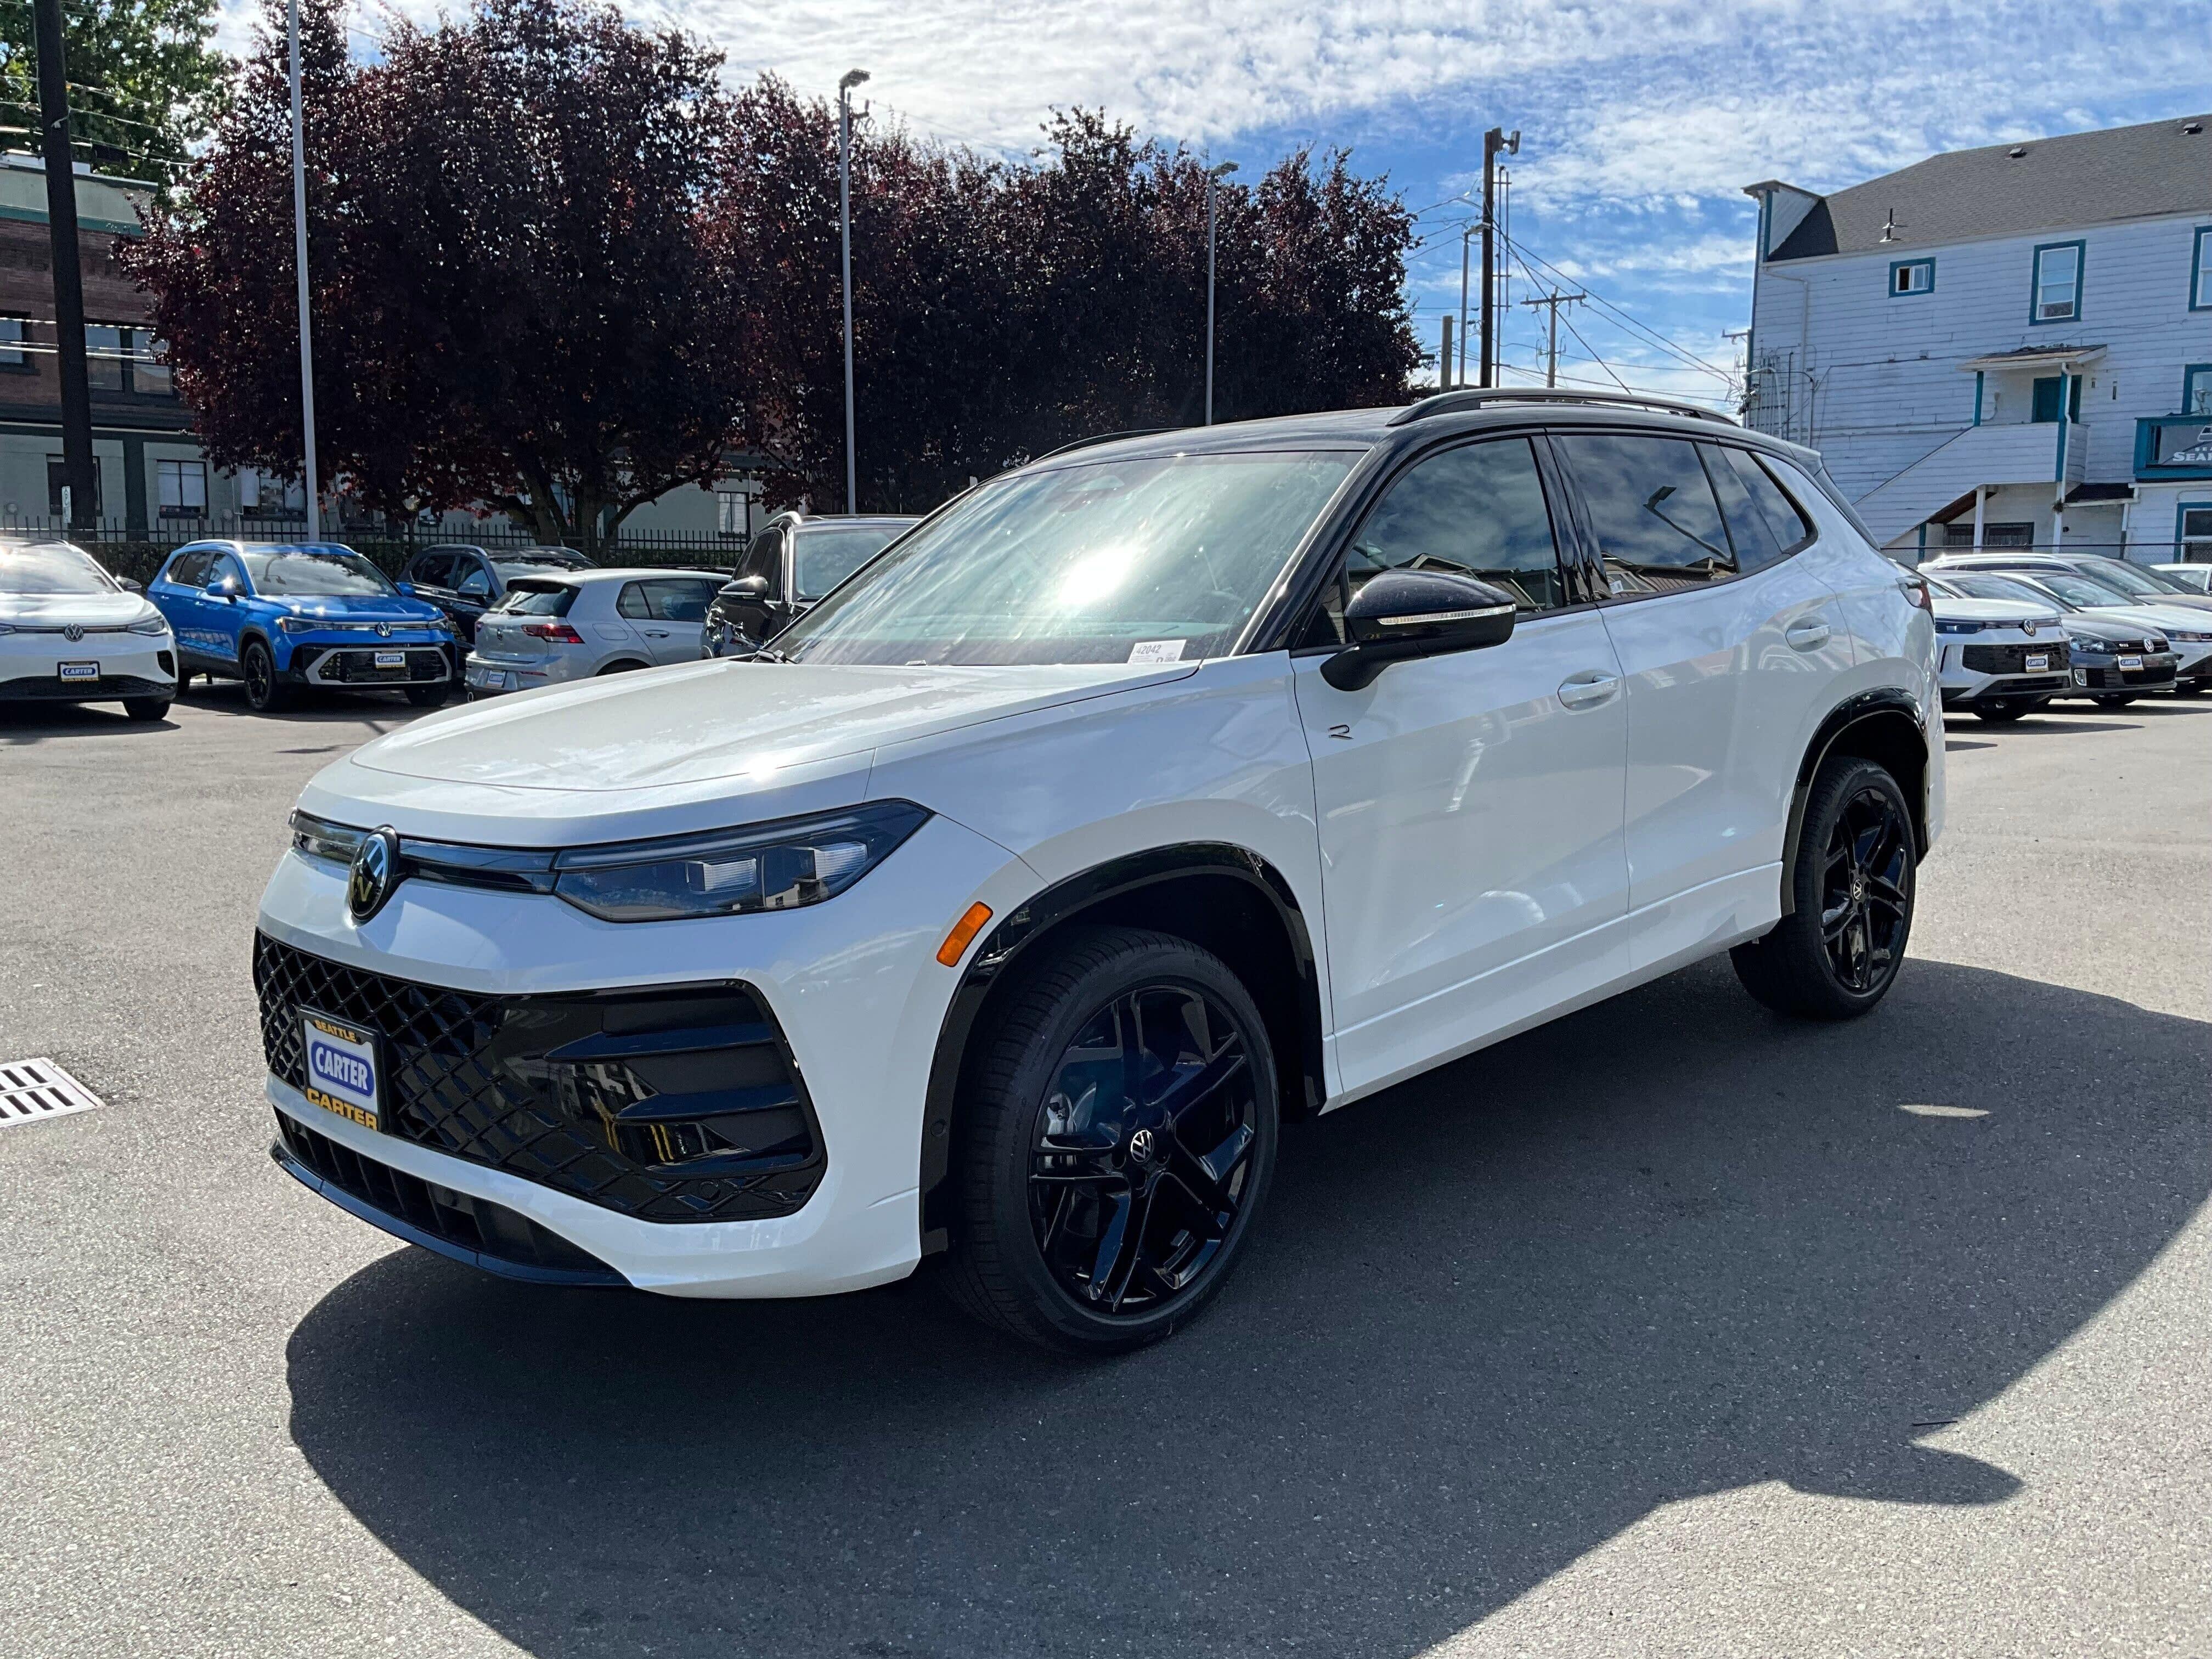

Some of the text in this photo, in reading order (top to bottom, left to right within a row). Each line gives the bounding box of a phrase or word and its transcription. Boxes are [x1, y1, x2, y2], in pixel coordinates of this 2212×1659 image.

[314, 1019, 357, 1042] SEATTLE
[315, 1046, 368, 1091] CARTER
[307, 1087, 378, 1131] CARTER
